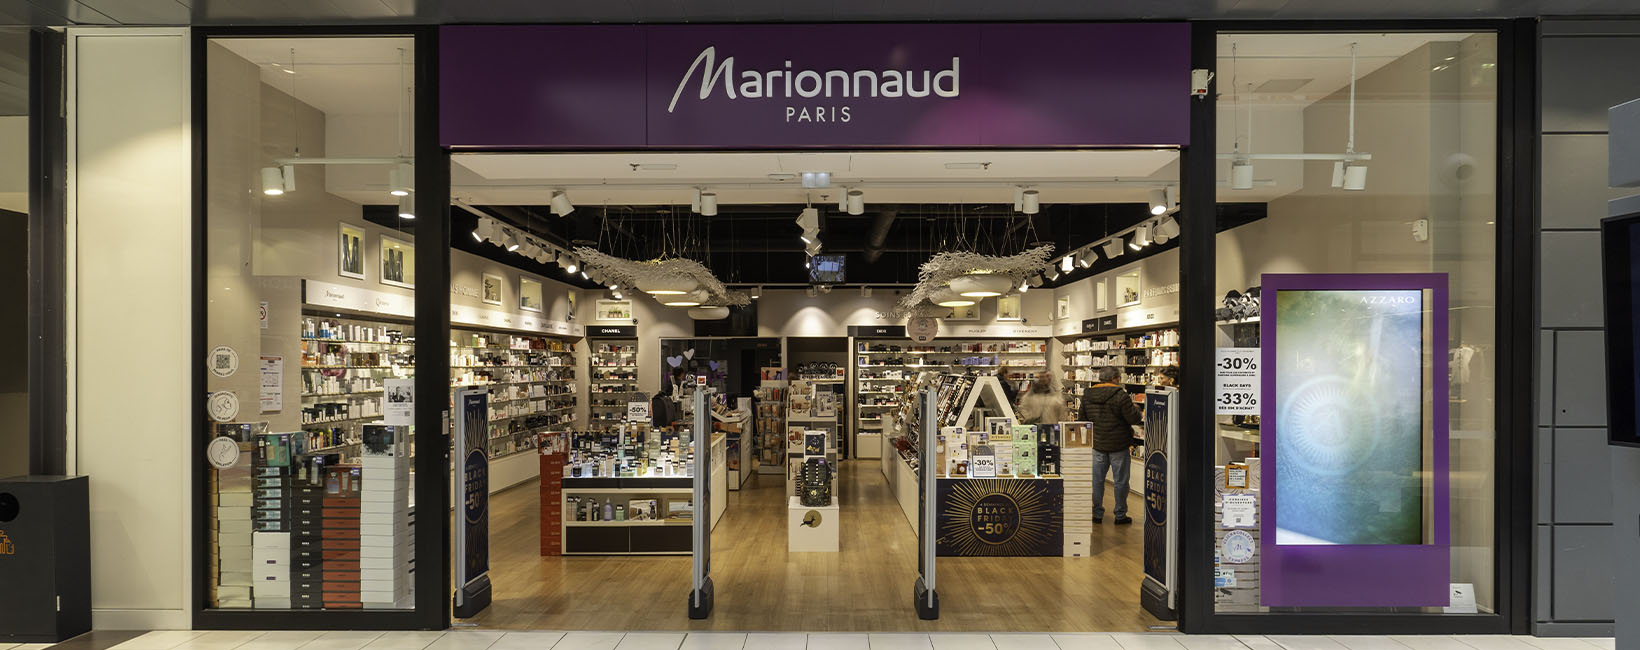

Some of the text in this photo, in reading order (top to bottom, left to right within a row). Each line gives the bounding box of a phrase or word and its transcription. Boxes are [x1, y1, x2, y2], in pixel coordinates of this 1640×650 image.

[667, 46, 960, 113] Marionnaud
[786, 106, 851, 123] PARIS
[1360, 296, 1415, 304] AZZARO
[1217, 357, 1257, 370] -30%
[1217, 393, 1257, 405] -33%
[1146, 468, 1165, 483] BLAC
[1146, 479, 1166, 496] FRIDA
[977, 522, 1013, 534] -50%
